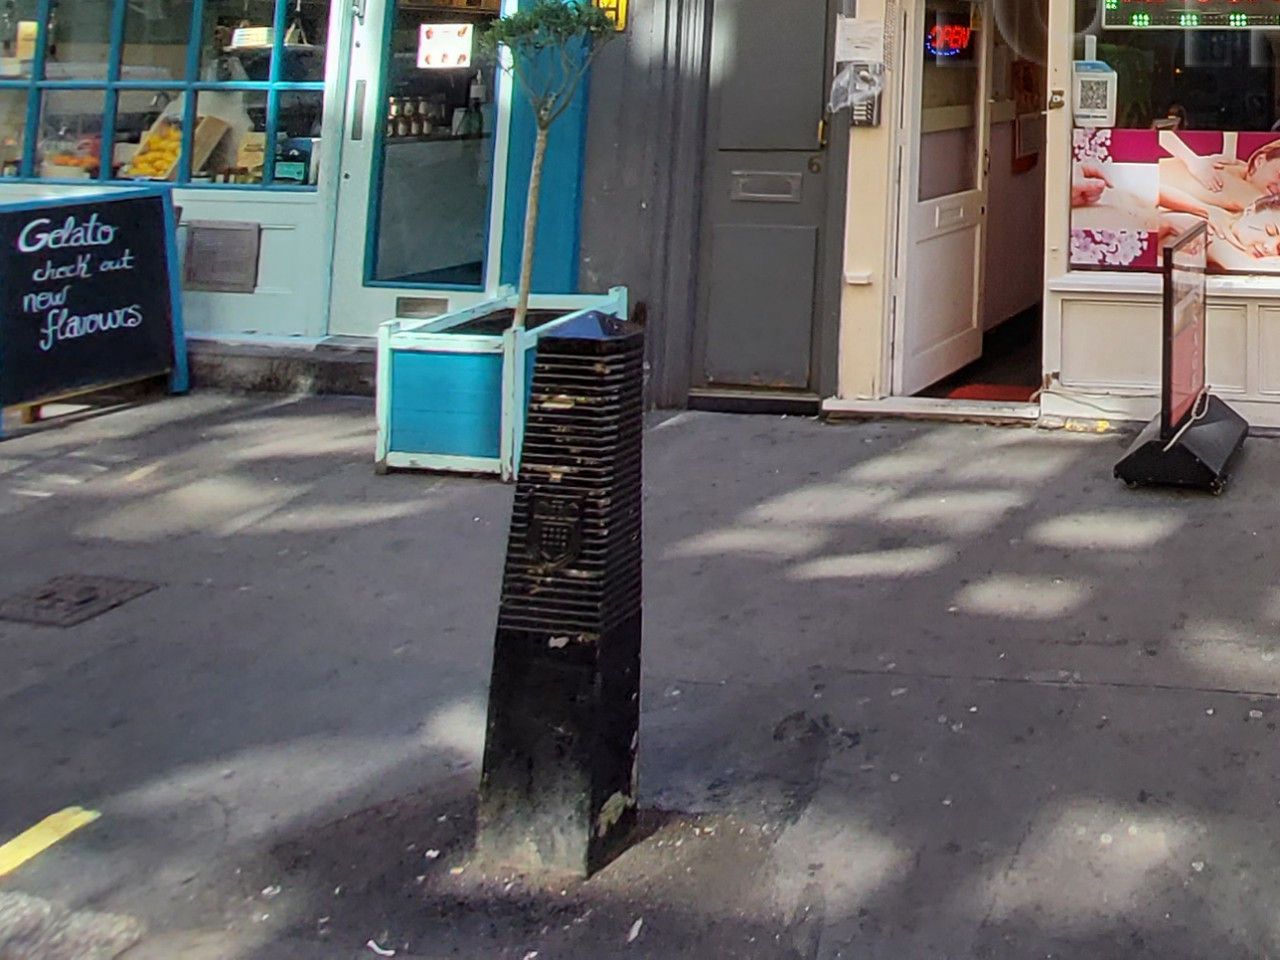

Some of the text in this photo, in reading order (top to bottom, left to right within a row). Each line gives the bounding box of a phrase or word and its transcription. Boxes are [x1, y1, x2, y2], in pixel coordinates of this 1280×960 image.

[18, 213, 118, 252] Gelato
[32, 249, 134, 281] check out
[23, 285, 71, 312] new
[39, 304, 142, 351] flavours
